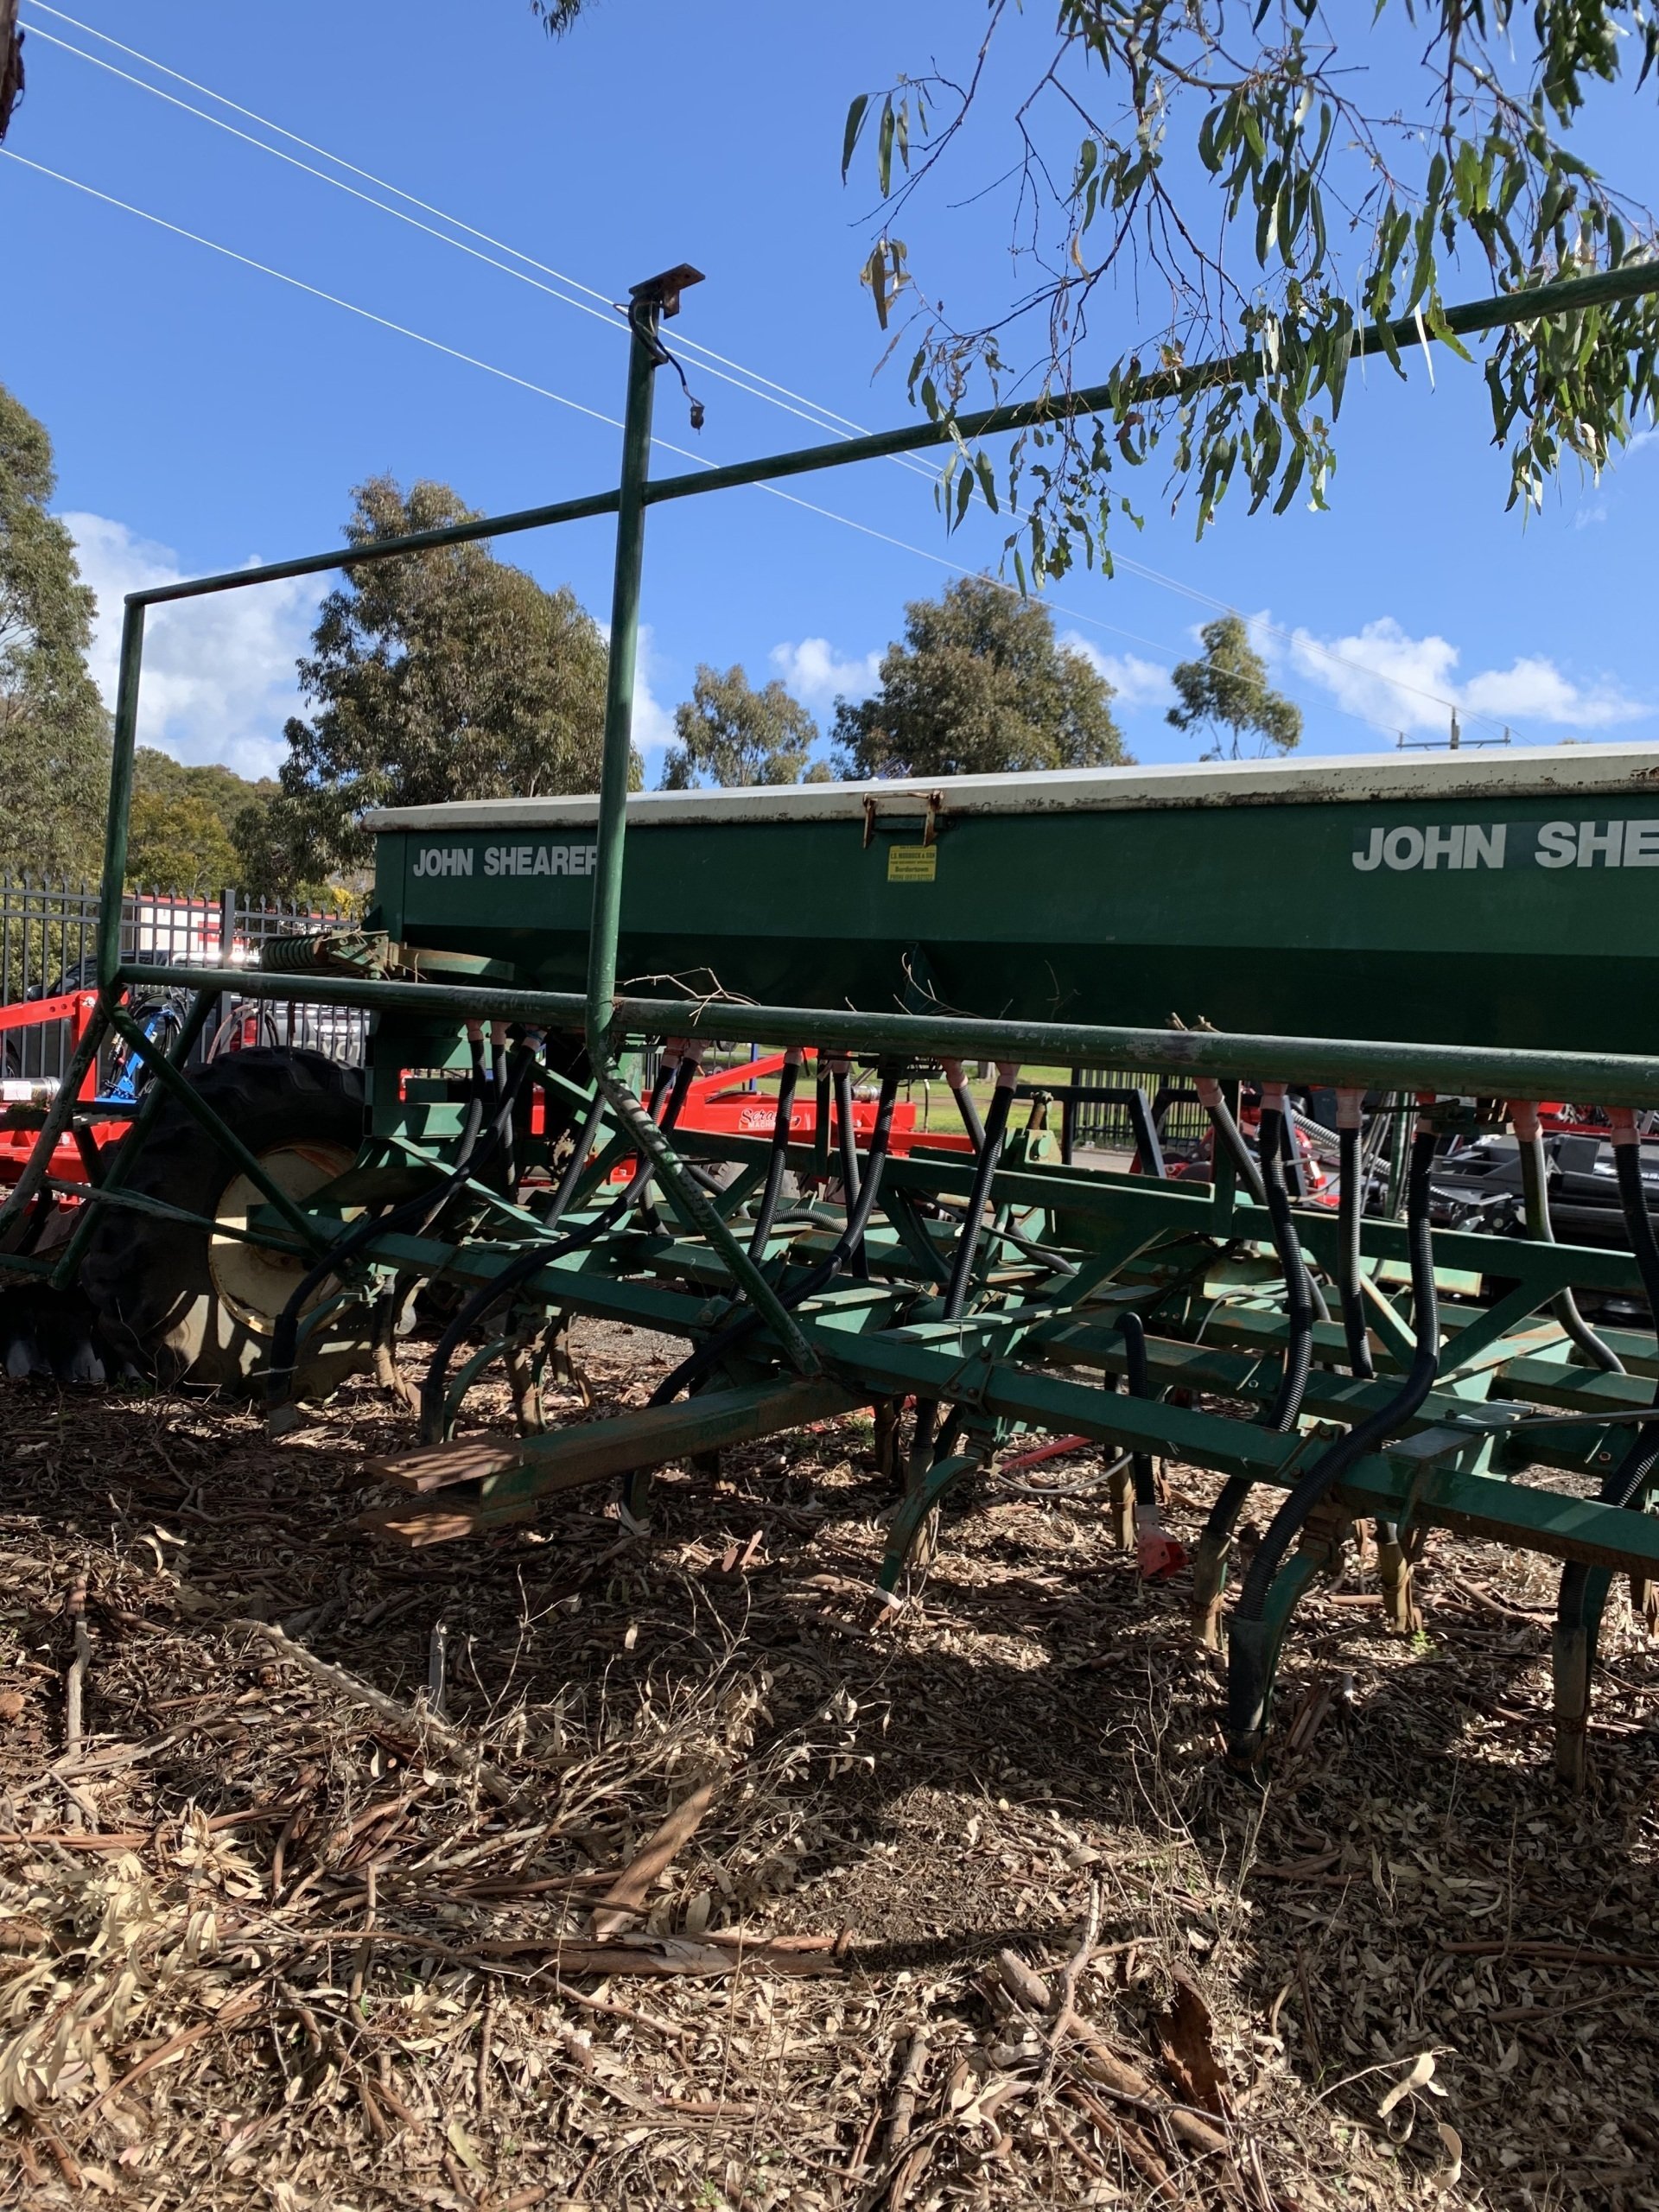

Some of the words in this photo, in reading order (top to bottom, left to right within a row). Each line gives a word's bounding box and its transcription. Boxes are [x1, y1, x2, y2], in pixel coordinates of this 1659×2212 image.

[1352, 824, 1506, 871] JOHN
[413, 849, 473, 876] JOHN
[740, 1109, 777, 1124] Sera
